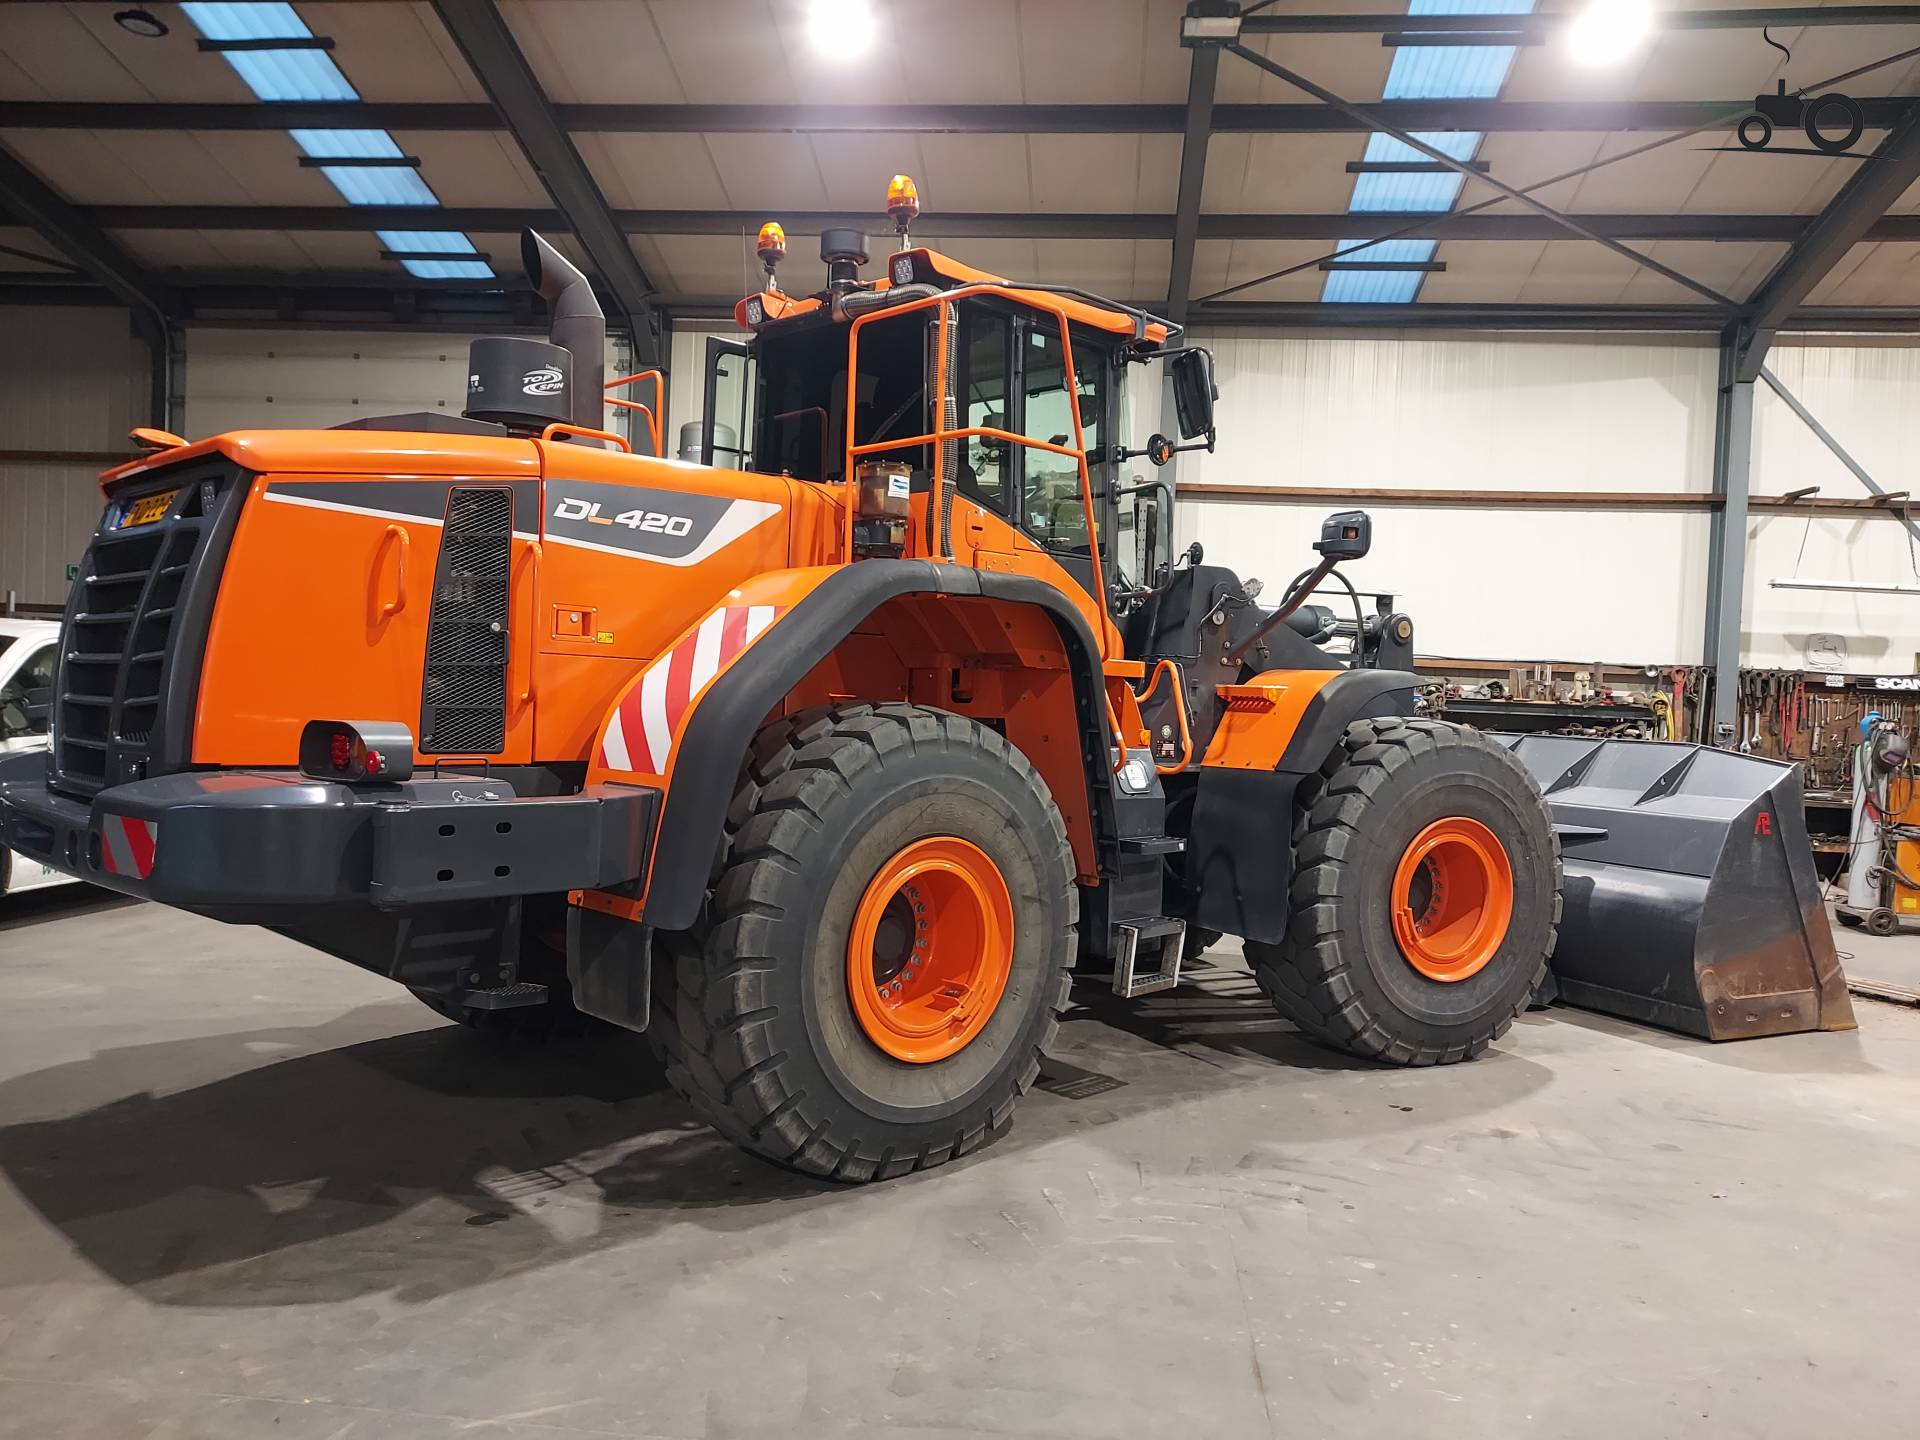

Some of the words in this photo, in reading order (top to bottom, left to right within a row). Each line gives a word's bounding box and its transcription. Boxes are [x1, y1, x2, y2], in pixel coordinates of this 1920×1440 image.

[522, 375, 552, 384] TOP
[539, 382, 564, 391] SPIN
[553, 497, 693, 537] DL420
